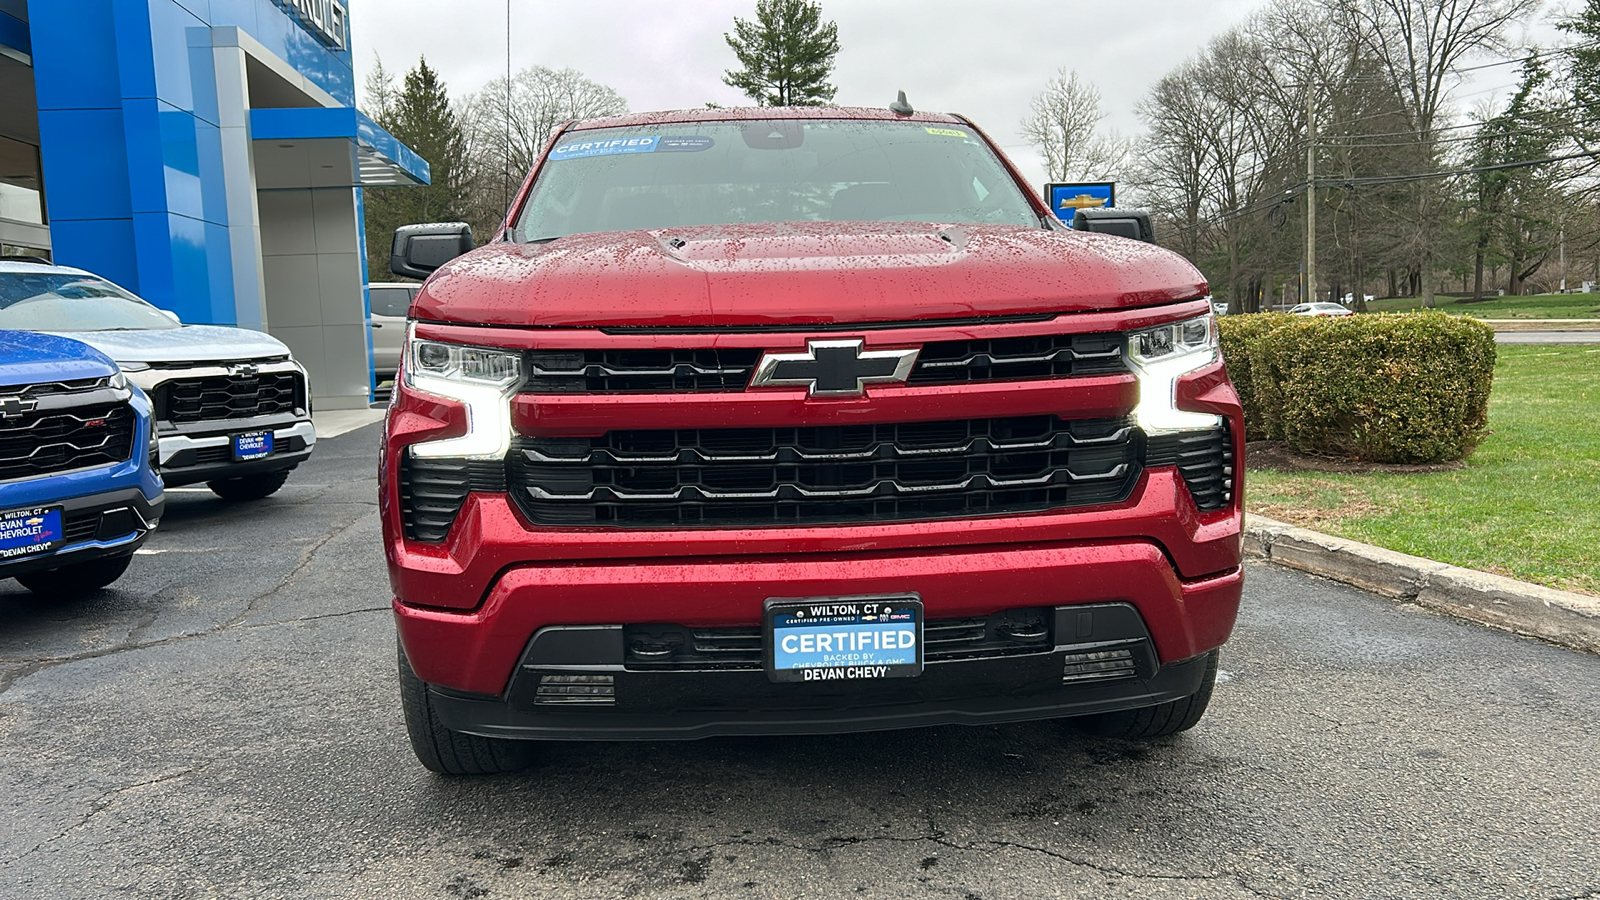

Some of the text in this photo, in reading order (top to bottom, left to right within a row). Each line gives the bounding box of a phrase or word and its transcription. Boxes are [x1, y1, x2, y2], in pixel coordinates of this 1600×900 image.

[556, 138, 654, 153] CERTIFIED
[0, 519, 23, 530] EVAN
[0, 526, 43, 539] HEVROLET
[3, 542, 48, 557] DEVAN CHEVY
[863, 604, 879, 614] CT
[781, 630, 916, 654] CERTIFIED
[823, 654, 860, 662] BACKED
[804, 666, 887, 681] DEVAN CHEVY
